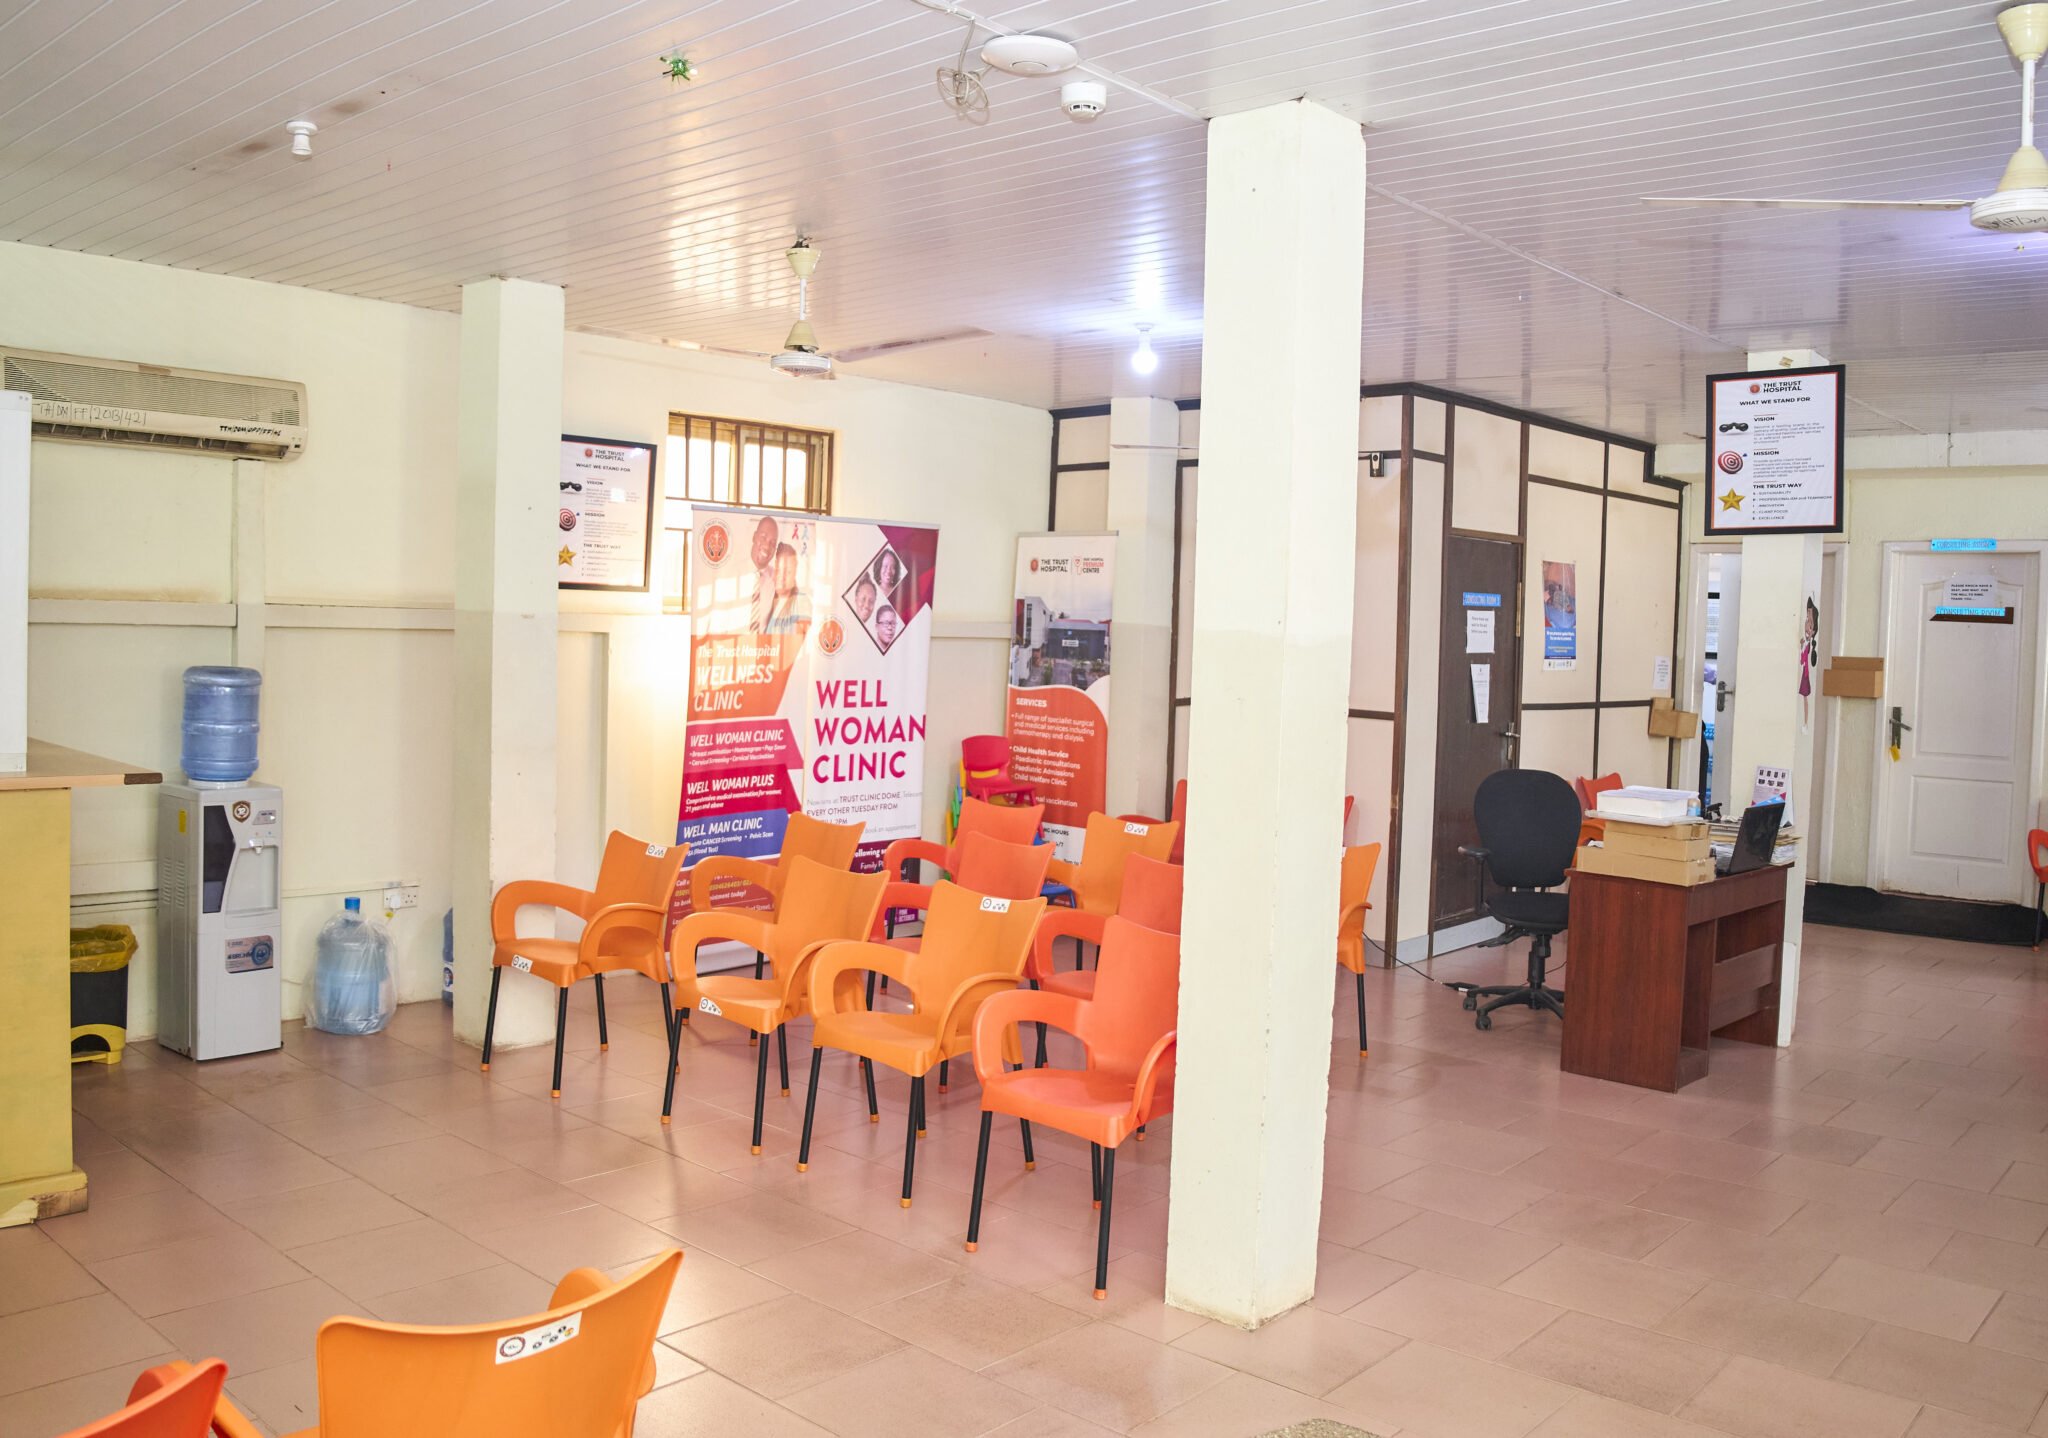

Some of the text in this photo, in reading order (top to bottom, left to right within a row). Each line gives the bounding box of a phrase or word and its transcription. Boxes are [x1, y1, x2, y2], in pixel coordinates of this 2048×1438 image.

[1041, 565, 1068, 573] HOSPITAL
[698, 643, 780, 660] The Trust Hospital
[696, 663, 775, 686] WELLNESS
[694, 688, 744, 712] CLINIC
[816, 679, 888, 710] WELL
[1016, 697, 1048, 708] SERVICES
[1024, 714, 1040, 723] range
[1025, 722, 1047, 730] medical
[690, 728, 784, 747] WELL WOMAN CLINIC
[814, 714, 926, 747] WOMAN
[1013, 745, 1069, 759] Child Health Service
[812, 750, 907, 784] CLINIC
[1015, 754, 1081, 770] Paediatric consultations
[1015, 763, 1075, 778] Paediatric Admissions
[687, 773, 775, 795] WELL WOMAN PLUS
[1014, 773, 1067, 786] Child Welfare Clinic
[840, 794, 860, 804] TRUST
[860, 793, 881, 802] CLINIC
[881, 790, 901, 800] DOME
[806, 802, 898, 817] EVERY OTHER TUESDAY FROM
[683, 816, 763, 839] WELL MAN CLINIC
[702, 838, 721, 846] CANCER
[855, 848, 880, 858] ollowing
[860, 860, 877, 870] Family
[676, 879, 687, 887] Call
